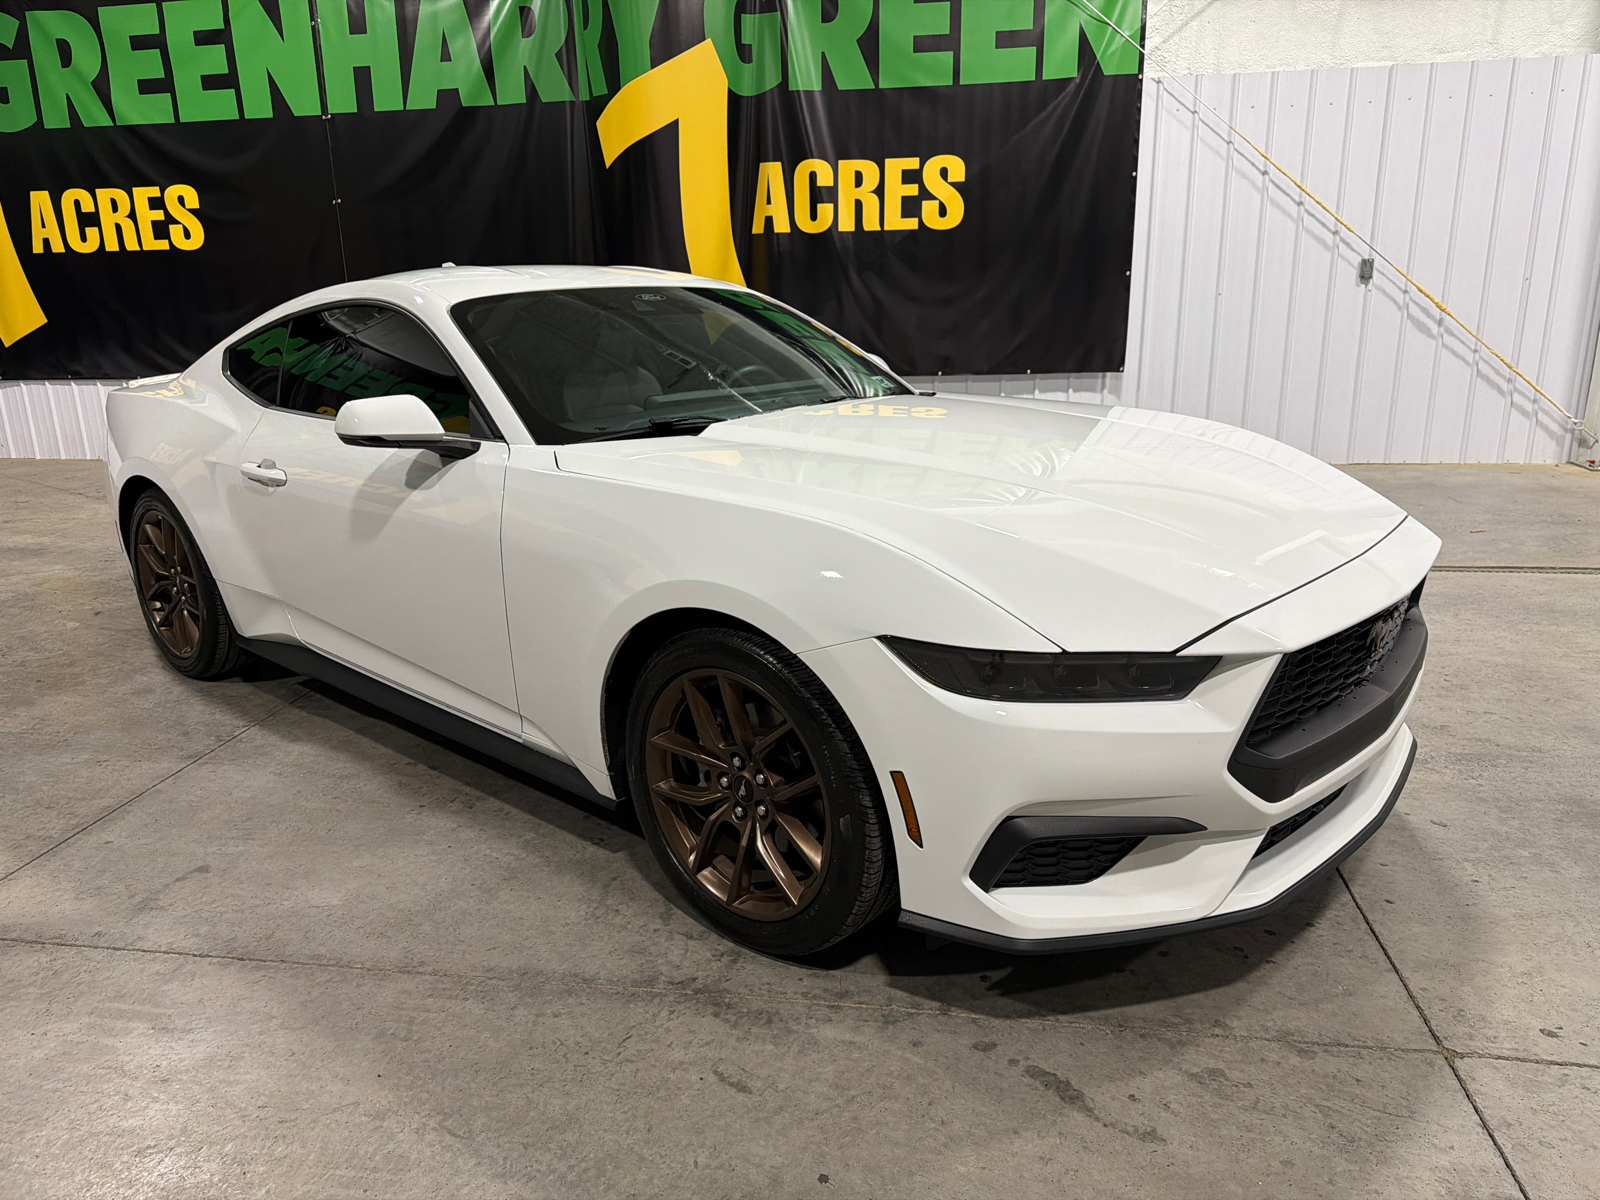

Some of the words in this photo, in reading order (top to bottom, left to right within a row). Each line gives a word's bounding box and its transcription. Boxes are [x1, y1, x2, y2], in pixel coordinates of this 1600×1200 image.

[703, 0, 1143, 97] GREEN
[596, 38, 748, 288] 7
[752, 154, 967, 234] ACRES
[29, 184, 205, 254] ACRES
